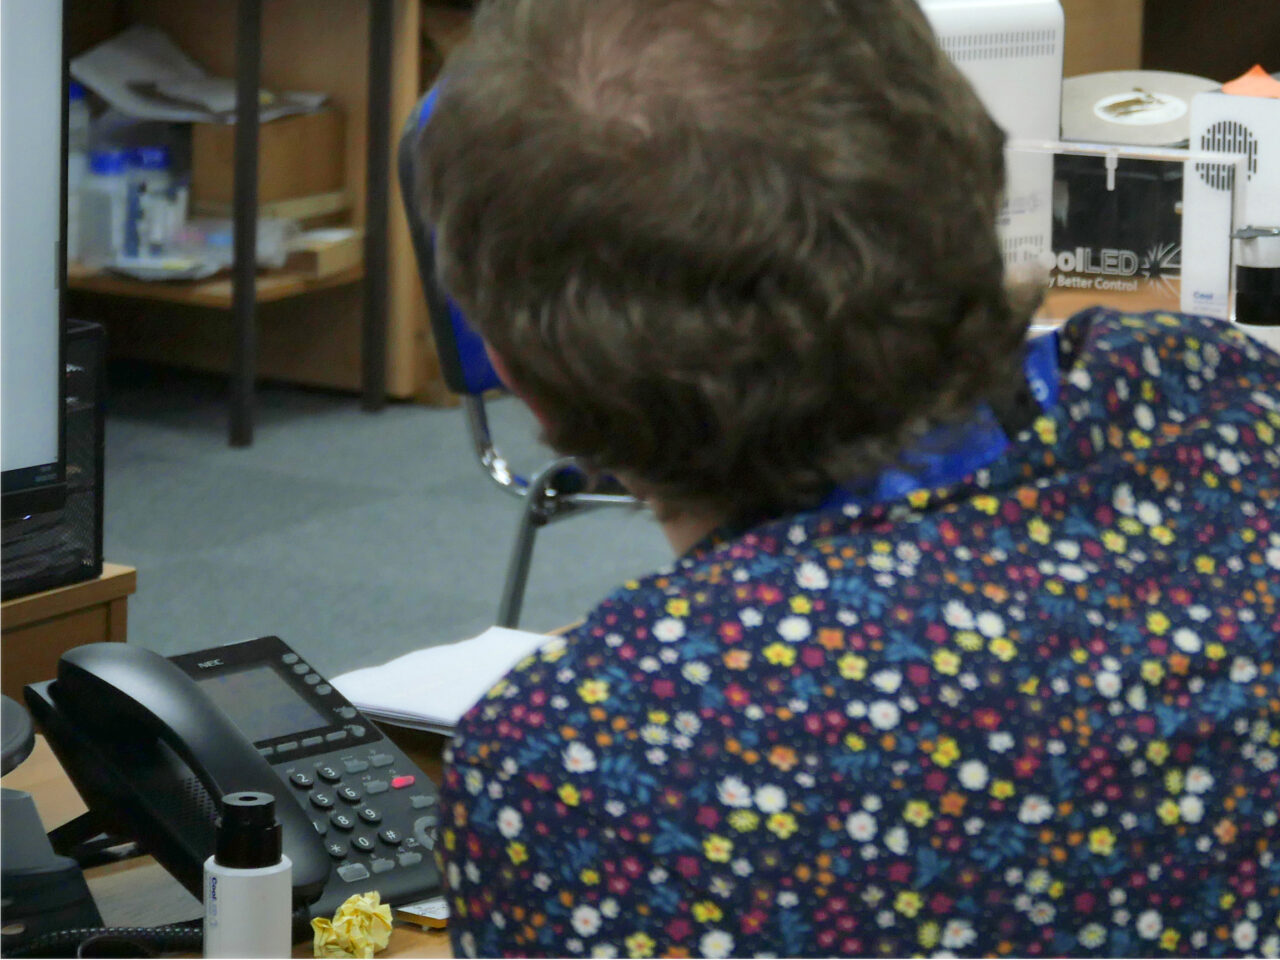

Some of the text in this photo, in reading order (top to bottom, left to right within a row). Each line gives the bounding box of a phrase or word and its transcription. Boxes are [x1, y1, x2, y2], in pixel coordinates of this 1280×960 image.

[1057, 275, 1092, 289] Better
[1094, 278, 1139, 291] Control
[197, 658, 225, 669] NEC
[297, 767, 336, 783] 2 3
[316, 787, 356, 804] 5 6
[337, 808, 376, 825] 8 9
